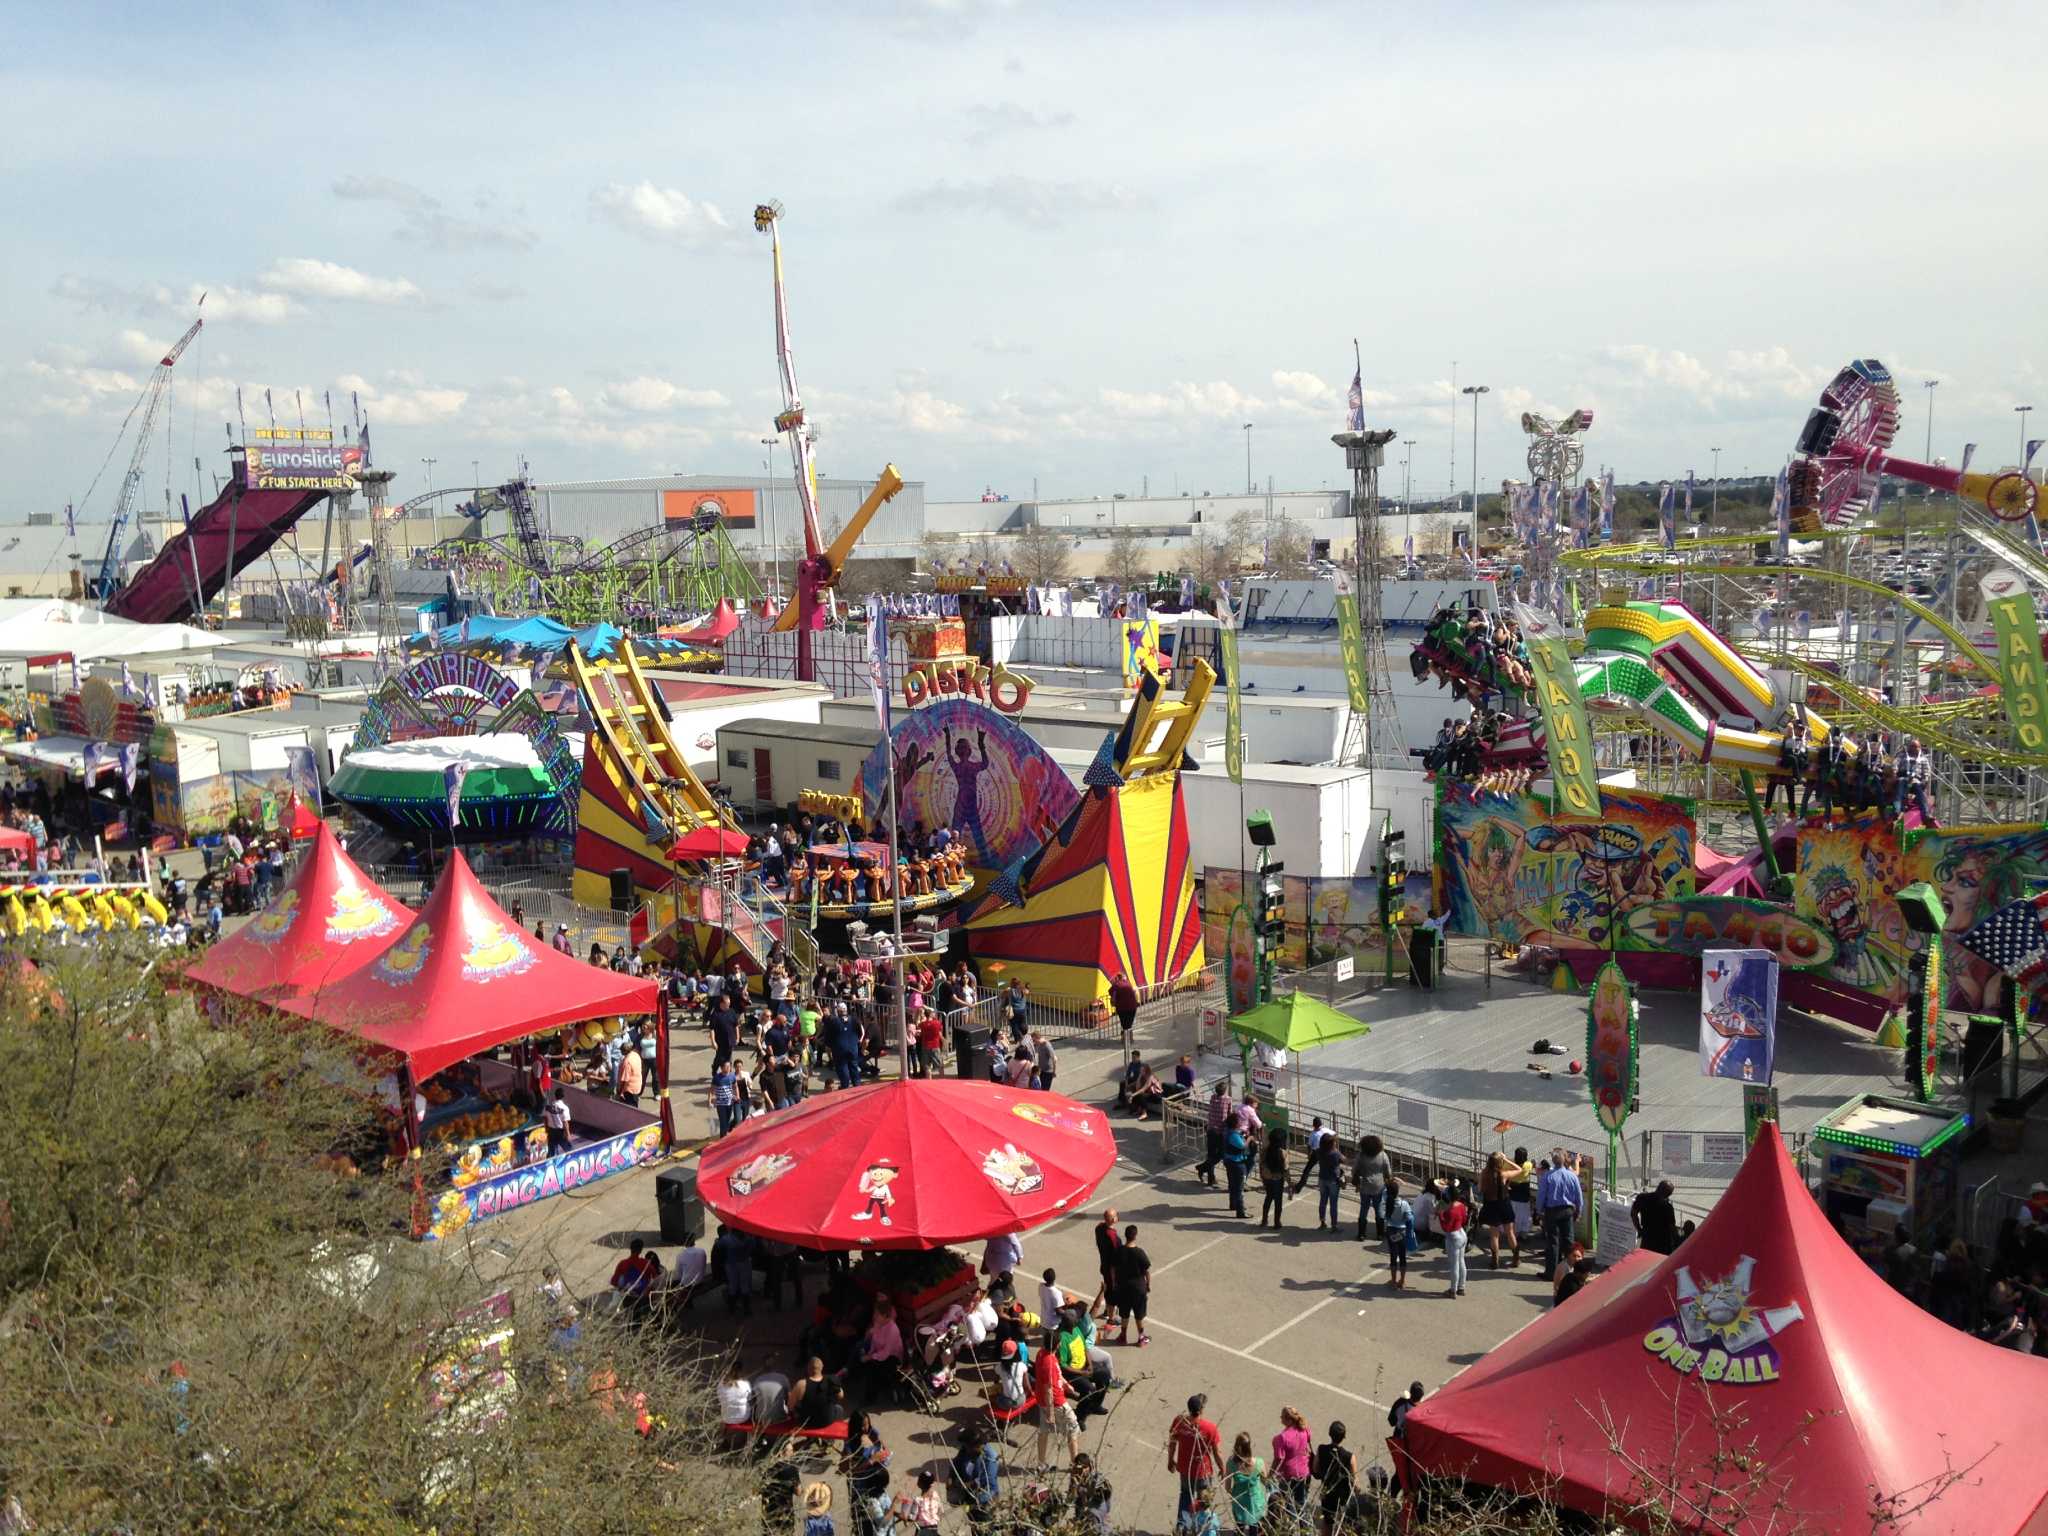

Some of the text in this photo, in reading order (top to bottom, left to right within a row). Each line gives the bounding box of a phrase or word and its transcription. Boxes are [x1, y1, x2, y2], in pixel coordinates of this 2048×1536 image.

[268, 477, 343, 488] FUN STARTS HERE
[399, 653, 519, 709] CENTRIFUGE
[902, 661, 1036, 713] DISKO
[1597, 828, 1637, 850] TANGO
[1649, 910, 1819, 958] TANGO
[1252, 1068, 1275, 1081] ENTER
[477, 1138, 626, 1217] RING A DUCK
[1643, 1326, 1781, 1384] ONE BALL
